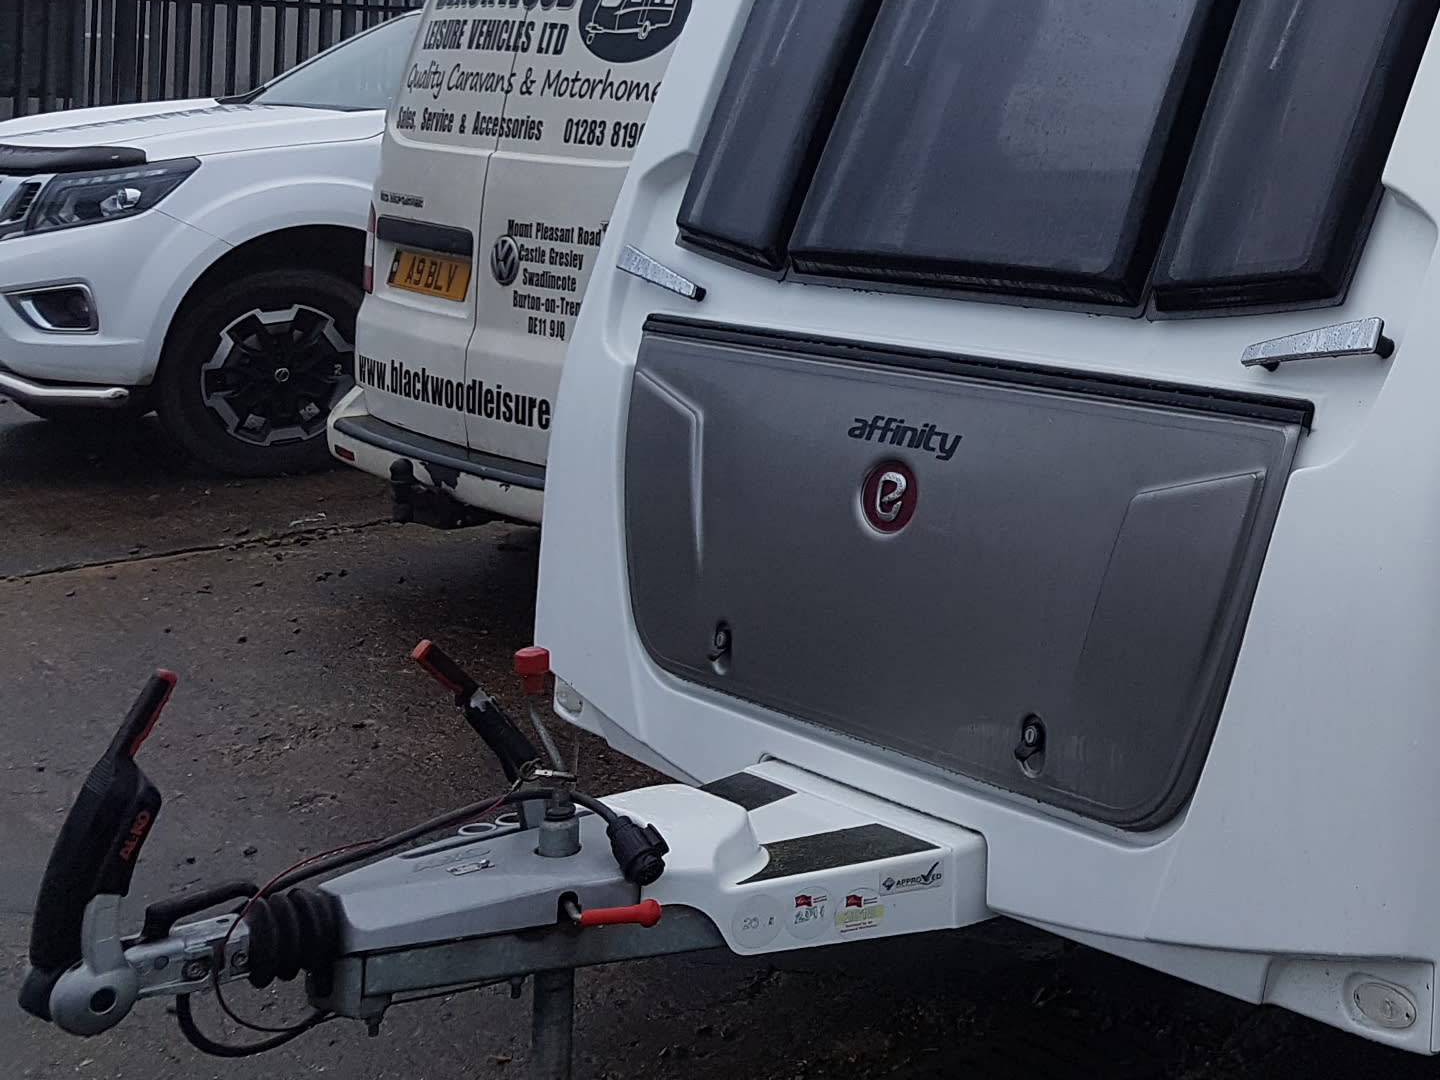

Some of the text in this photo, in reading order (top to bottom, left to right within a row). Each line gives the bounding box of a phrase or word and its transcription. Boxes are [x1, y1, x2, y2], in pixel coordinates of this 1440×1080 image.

[422, 19, 570, 55] LEISURE VEHICLES LTD
[406, 60, 444, 100] Quality
[448, 63, 516, 95] Caravans
[519, 66, 537, 97] &
[396, 105, 416, 132] Sales,
[420, 106, 454, 133] Service
[458, 111, 467, 134] &
[471, 110, 543, 141] Accessories
[563, 117, 605, 146] 01283
[507, 219, 533, 239] Mount
[535, 222, 574, 244] Pleasant
[577, 226, 601, 247] Road
[519, 243, 584, 271] Castle Gresley
[522, 267, 577, 293] Swadlincote
[527, 316, 566, 341] DE11 9JQ
[358, 354, 551, 431] www.blackwoodleisure
[847, 415, 964, 461] affinity
